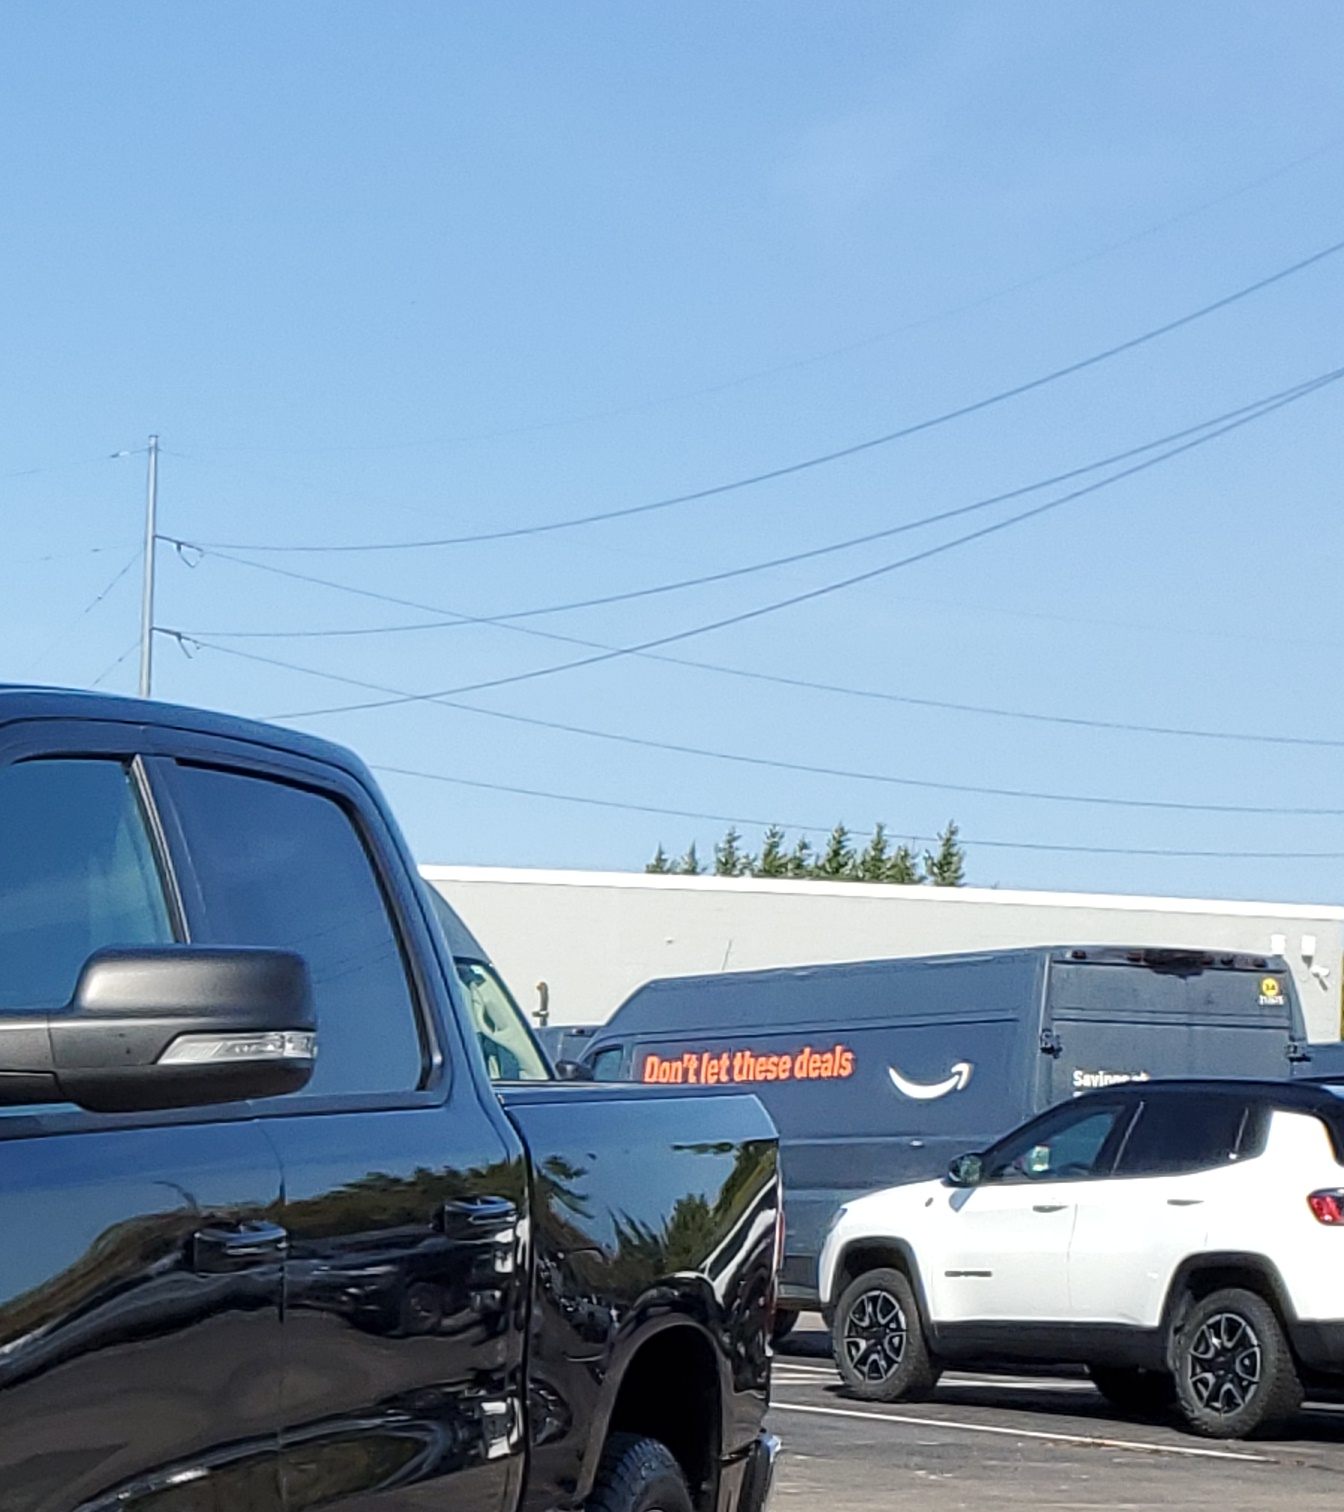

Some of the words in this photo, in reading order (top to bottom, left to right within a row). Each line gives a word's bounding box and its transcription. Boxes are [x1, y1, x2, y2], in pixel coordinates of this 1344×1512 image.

[643, 1053, 698, 1083] Don't
[700, 1052, 730, 1084] let
[733, 1050, 792, 1082] these
[794, 1045, 855, 1079] deals
